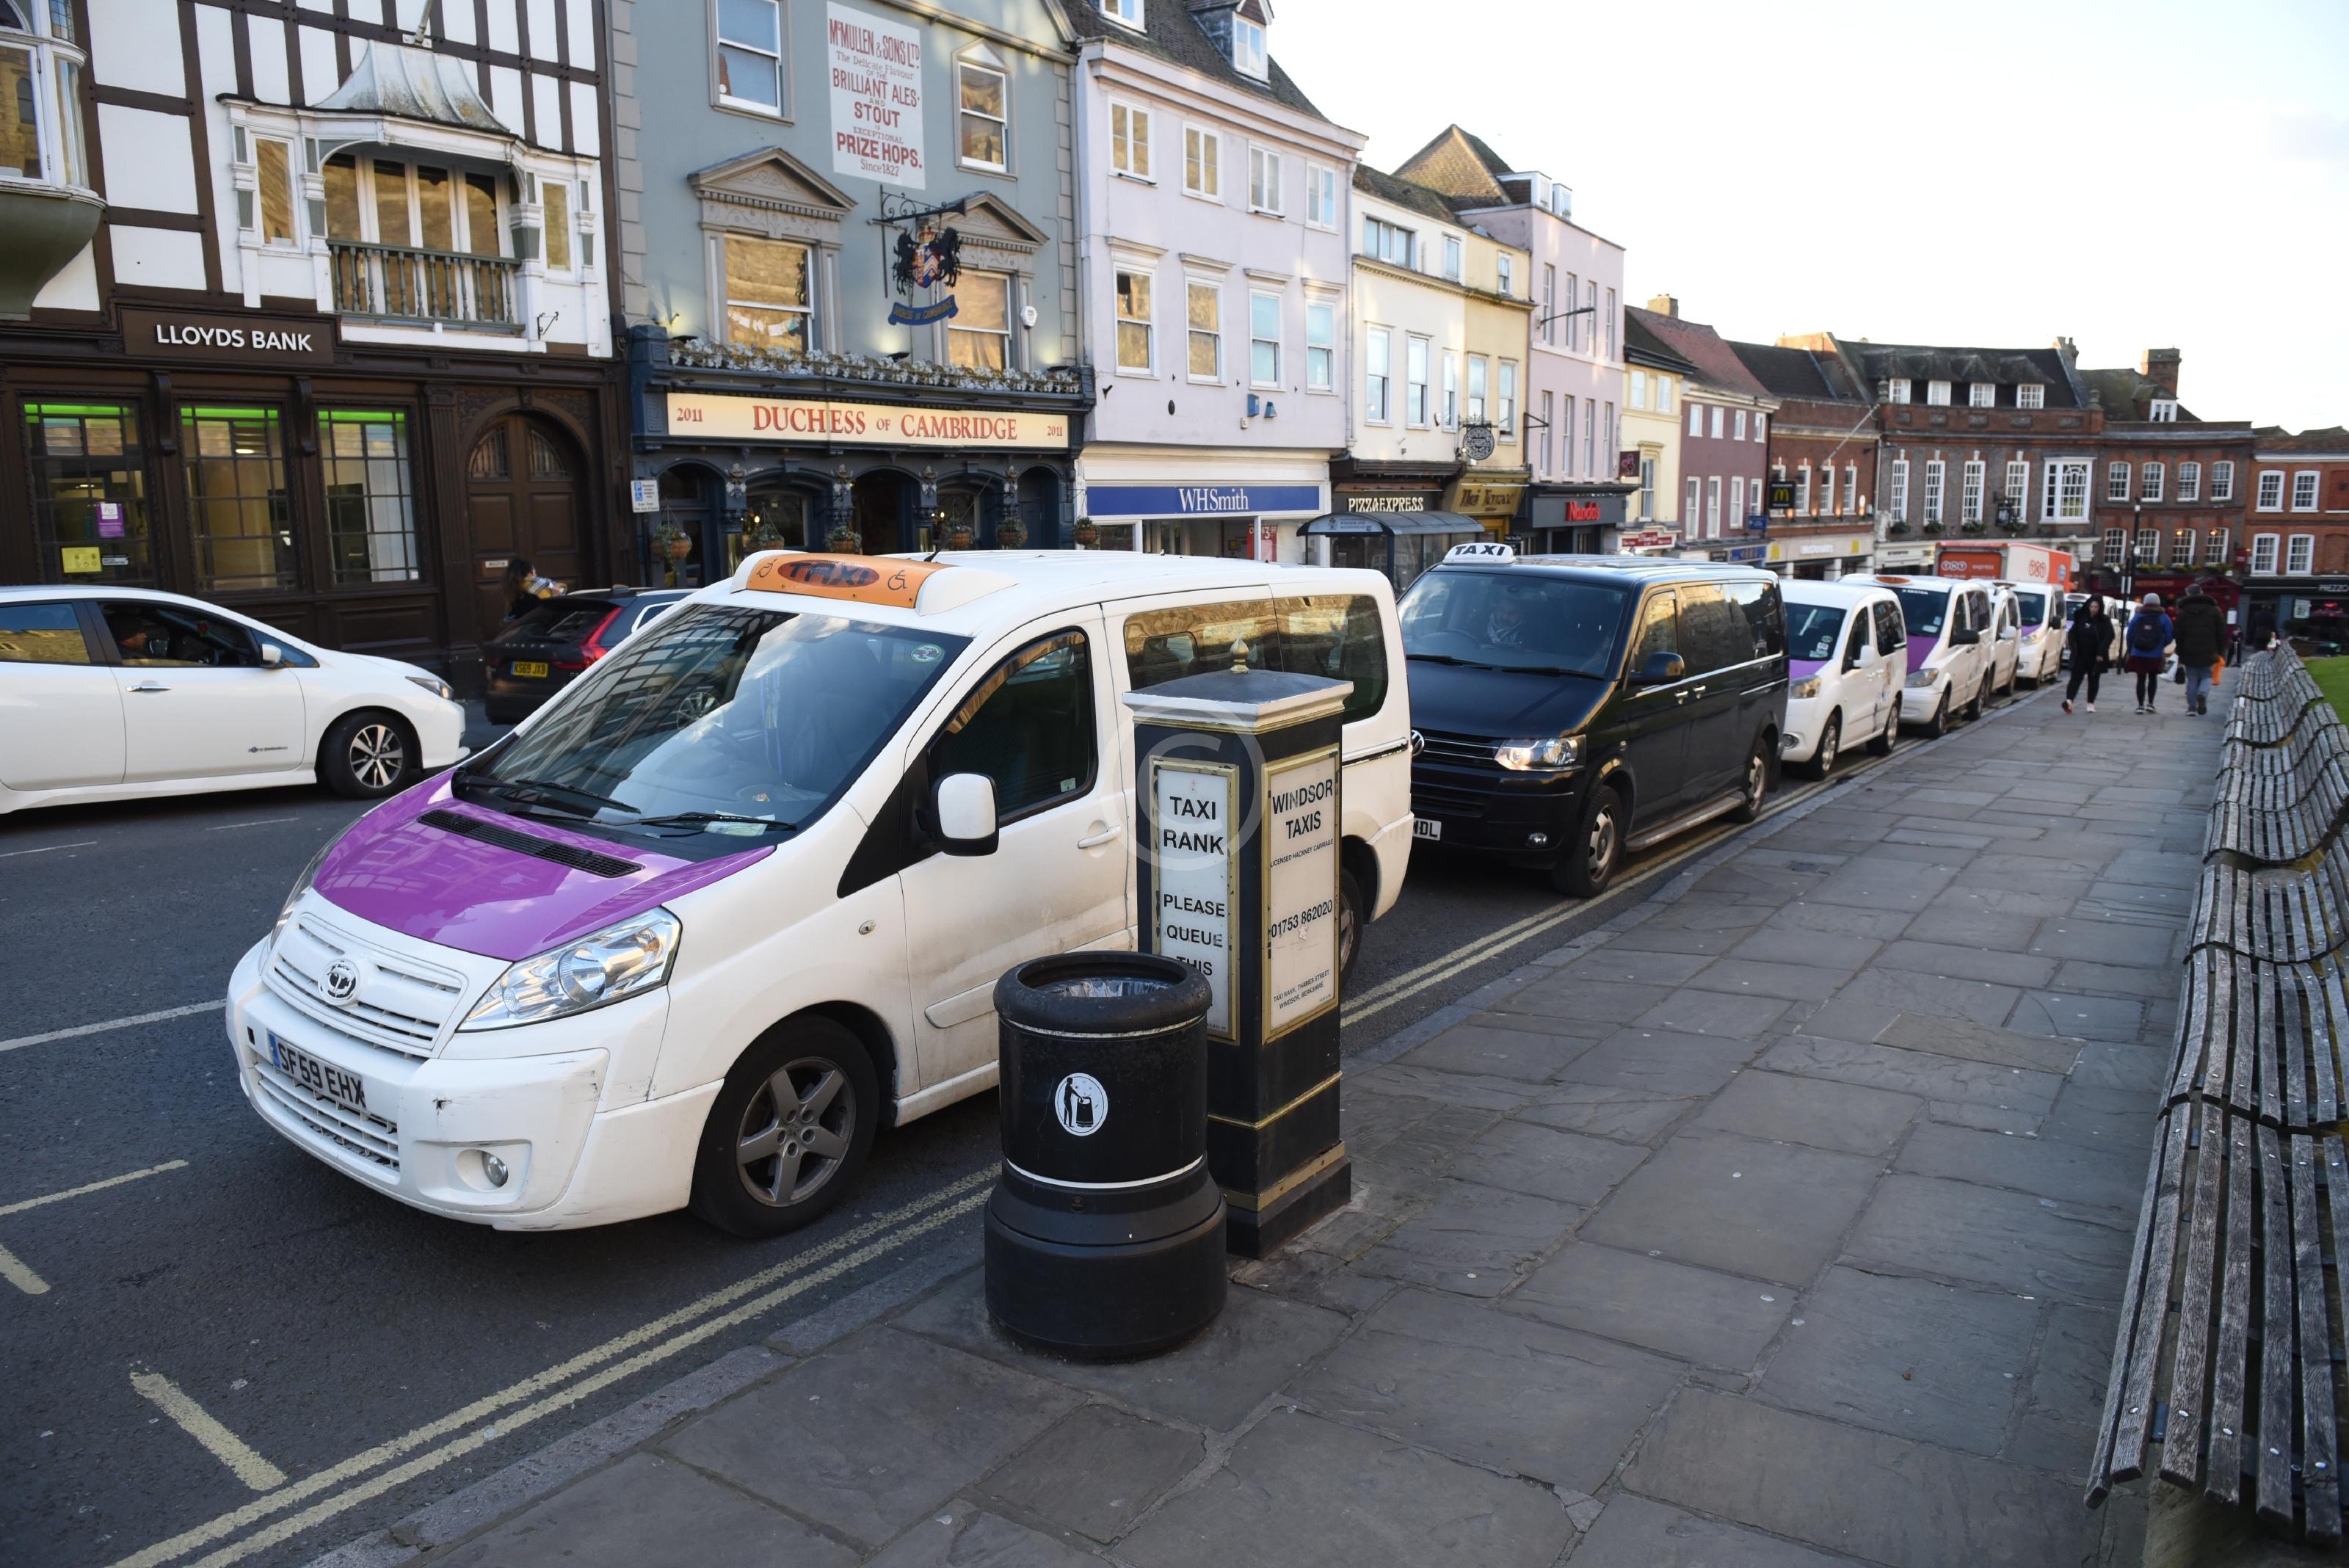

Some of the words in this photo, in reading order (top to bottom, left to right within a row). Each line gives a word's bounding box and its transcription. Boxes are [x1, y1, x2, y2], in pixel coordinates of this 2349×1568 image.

[876, 42, 882, 59] &
[882, 35, 906, 65] SONS
[836, 50, 851, 63] The
[853, 55, 883, 73] Delicate
[885, 64, 915, 80] Flavour
[876, 72, 887, 81] THE
[832, 68, 888, 99] BRILLIANT
[854, 101, 900, 128] STOUT
[869, 98, 885, 107] AND
[853, 126, 904, 144] EXCEPTIONAL
[837, 131, 879, 159] PRIZE
[882, 142, 923, 169] HOPS.
[860, 159, 882, 173] Since
[882, 162, 900, 177] 1827
[156, 324, 245, 348] LLOYDS
[252, 330, 313, 352] BANK
[676, 407, 703, 422] 2011
[753, 405, 866, 435] DUCHESS
[876, 418, 891, 431] OF
[901, 413, 1018, 440] CAMBRIDGE
[1047, 425, 1063, 437] 2011
[1179, 487, 1249, 512] WHSmith
[1455, 545, 1506, 556] TAXI
[789, 562, 871, 586] TAXI
[1941, 561, 1967, 571] TNT
[1169, 796, 1216, 821] TAXI
[1272, 778, 1333, 815] WINDSOR
[1286, 810, 1321, 839] TAXIS
[1163, 829, 1224, 856] RANK
[1270, 854, 1292, 868] LICENSED
[1292, 846, 1313, 860] HACKNEY
[1313, 838, 1334, 852] CARRIAGE
[1163, 893, 1225, 918] PLEASE
[1271, 914, 1299, 938] 01753
[1301, 899, 1333, 924] 862020
[1166, 924, 1223, 948] QUEUE
[1274, 993, 1283, 1003] TAXI
[1298, 977, 1314, 990] THAMES
[277, 1042, 323, 1089] SF59
[324, 1066, 366, 1108] EHX
